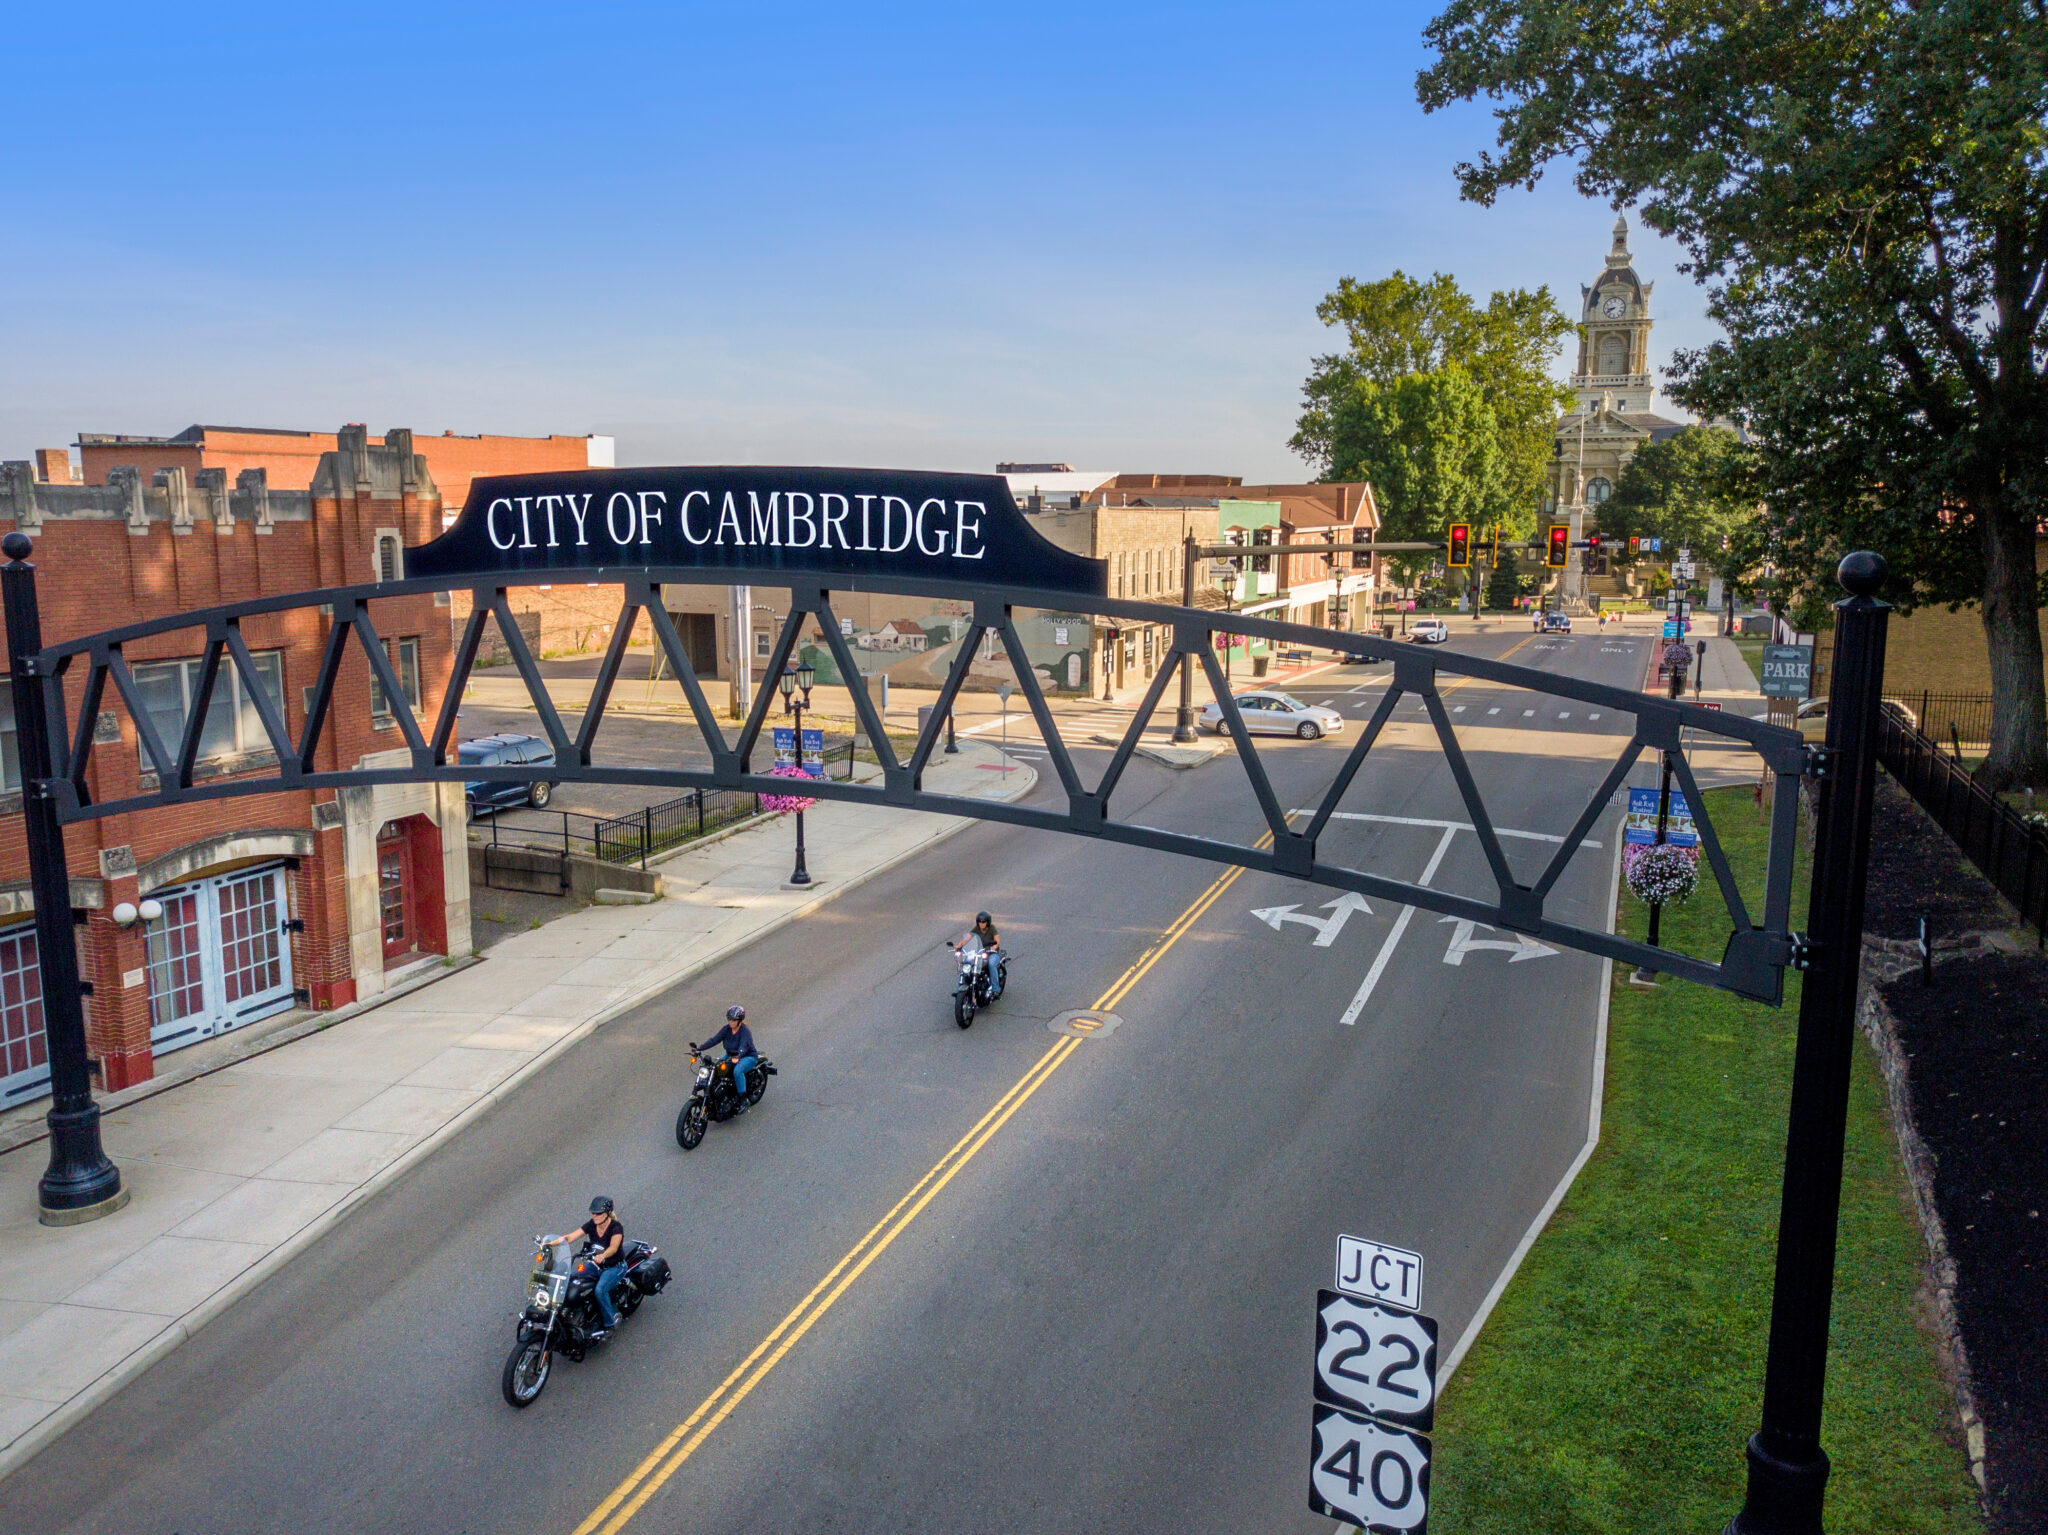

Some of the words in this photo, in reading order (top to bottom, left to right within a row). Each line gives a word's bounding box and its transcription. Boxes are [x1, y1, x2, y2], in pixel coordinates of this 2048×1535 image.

[486, 492, 594, 550] CITY
[606, 490, 668, 546] OF
[680, 490, 987, 560] CAMBRIDGE
[1042, 616, 1082, 625] HOLLYWOOD
[1763, 662, 1809, 678] PARK
[1342, 1248, 1415, 1298] JCT
[1328, 1319, 1420, 1400] 22
[1320, 1438, 1413, 1511] 40
